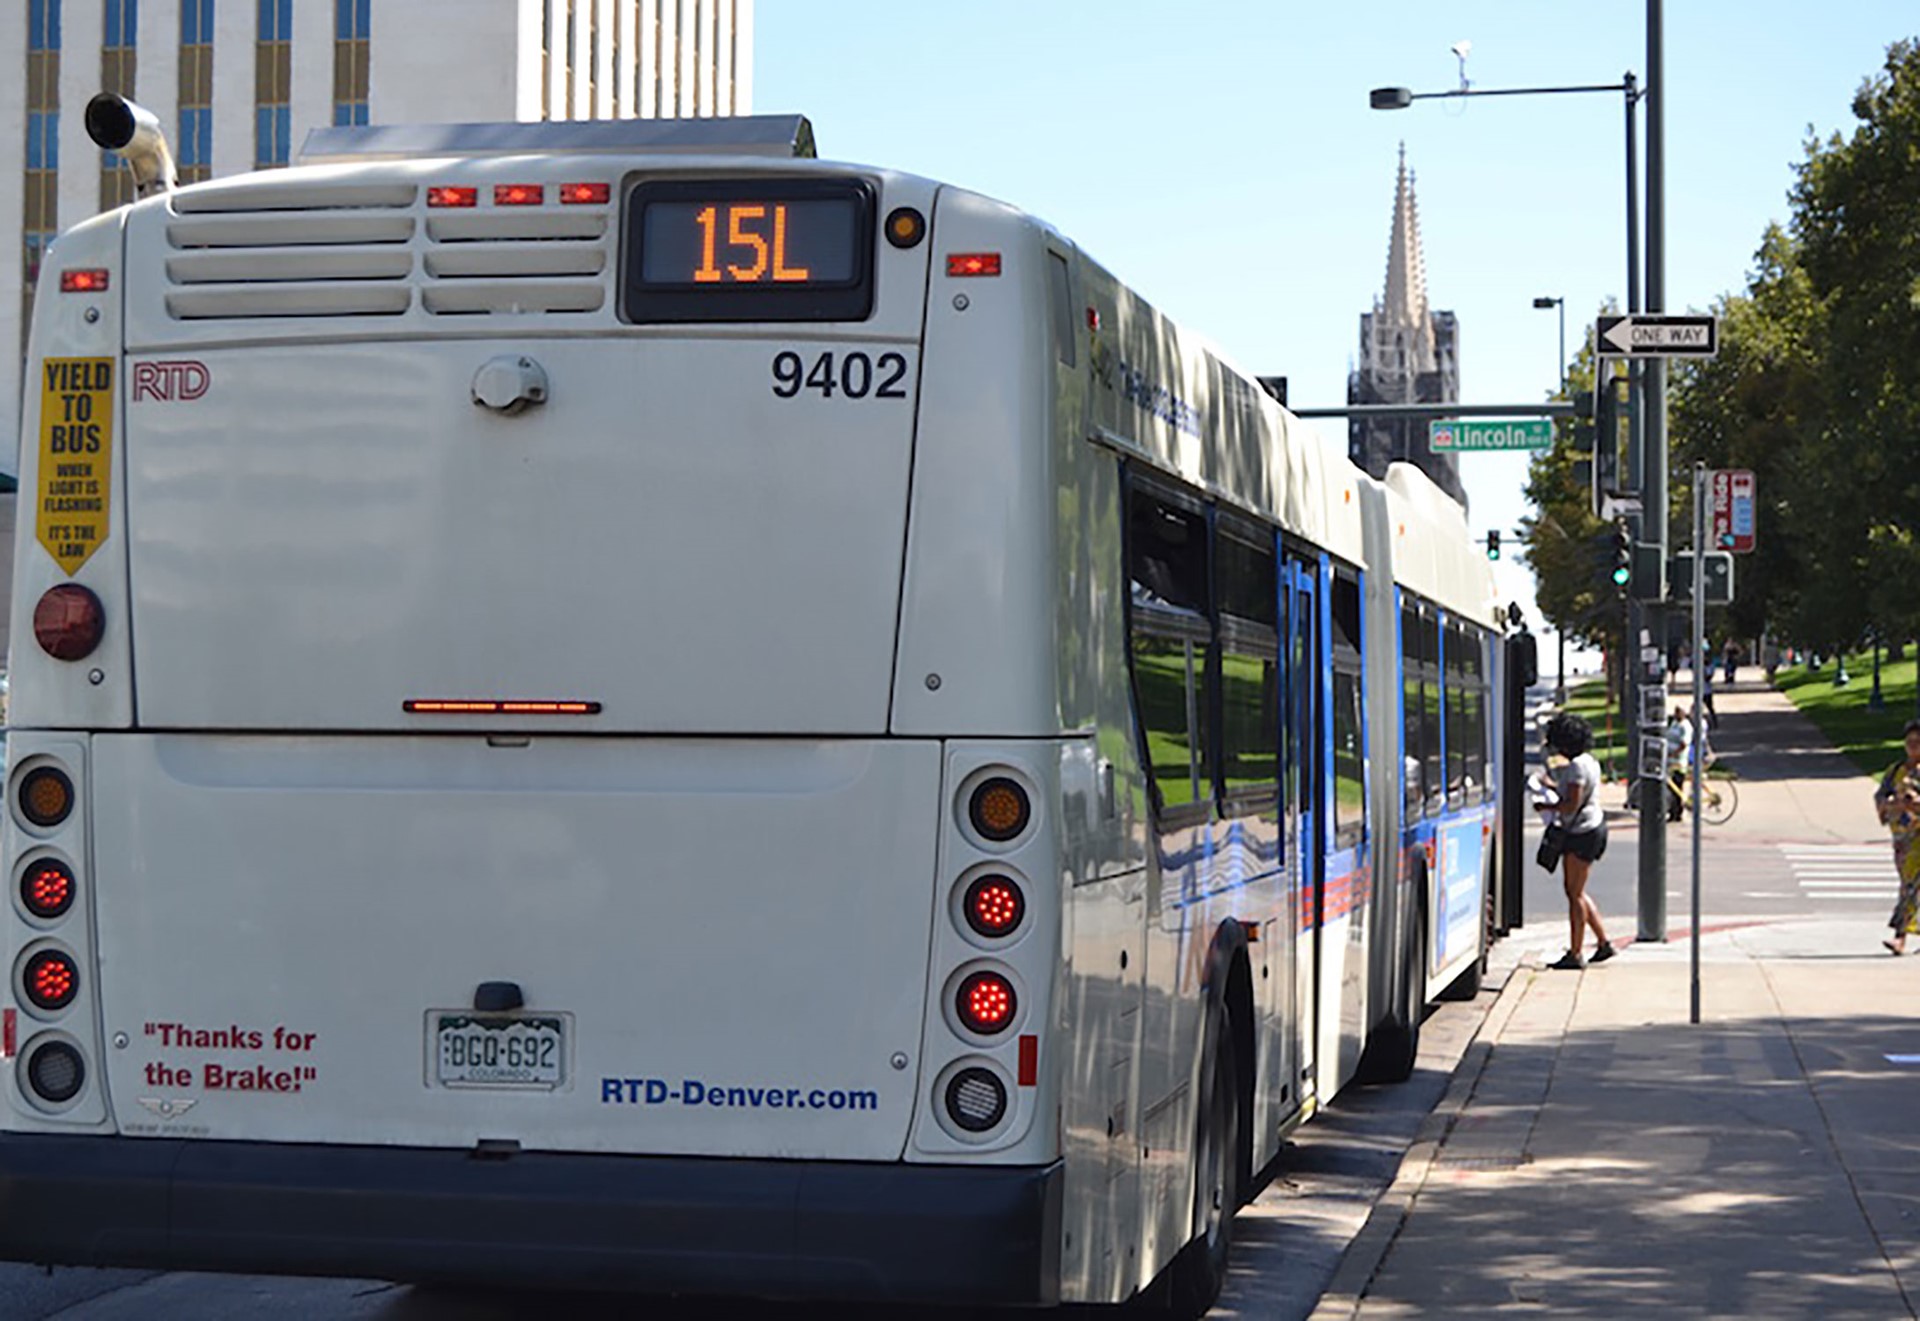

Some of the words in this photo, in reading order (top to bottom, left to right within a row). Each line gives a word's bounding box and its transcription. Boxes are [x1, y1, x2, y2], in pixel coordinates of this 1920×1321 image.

[694, 205, 808, 282] 15L
[1632, 328, 1663, 343] ONE
[1669, 328, 1703, 342] WAY
[46, 362, 111, 392] YIELD
[134, 361, 211, 401] RTD
[772, 351, 908, 399] 9402
[61, 394, 92, 421] TO
[51, 425, 100, 453] BUS
[1455, 425, 1526, 447] Lincoln
[57, 463, 92, 477] WHEN
[48, 481, 83, 495] LIGHT
[86, 480, 98, 494] IS
[45, 497, 102, 512] FLASHING
[48, 525, 71, 540] IT'S
[74, 525, 96, 540] THE
[58, 542, 85, 557] LAW
[144, 1022, 263, 1049] "Thanks
[273, 1026, 316, 1050] for
[145, 1062, 192, 1087] the
[204, 1064, 316, 1092] Brake!"
[469, 1068, 532, 1080] COLORADO
[601, 1078, 878, 1110] RTD-Denver.com
